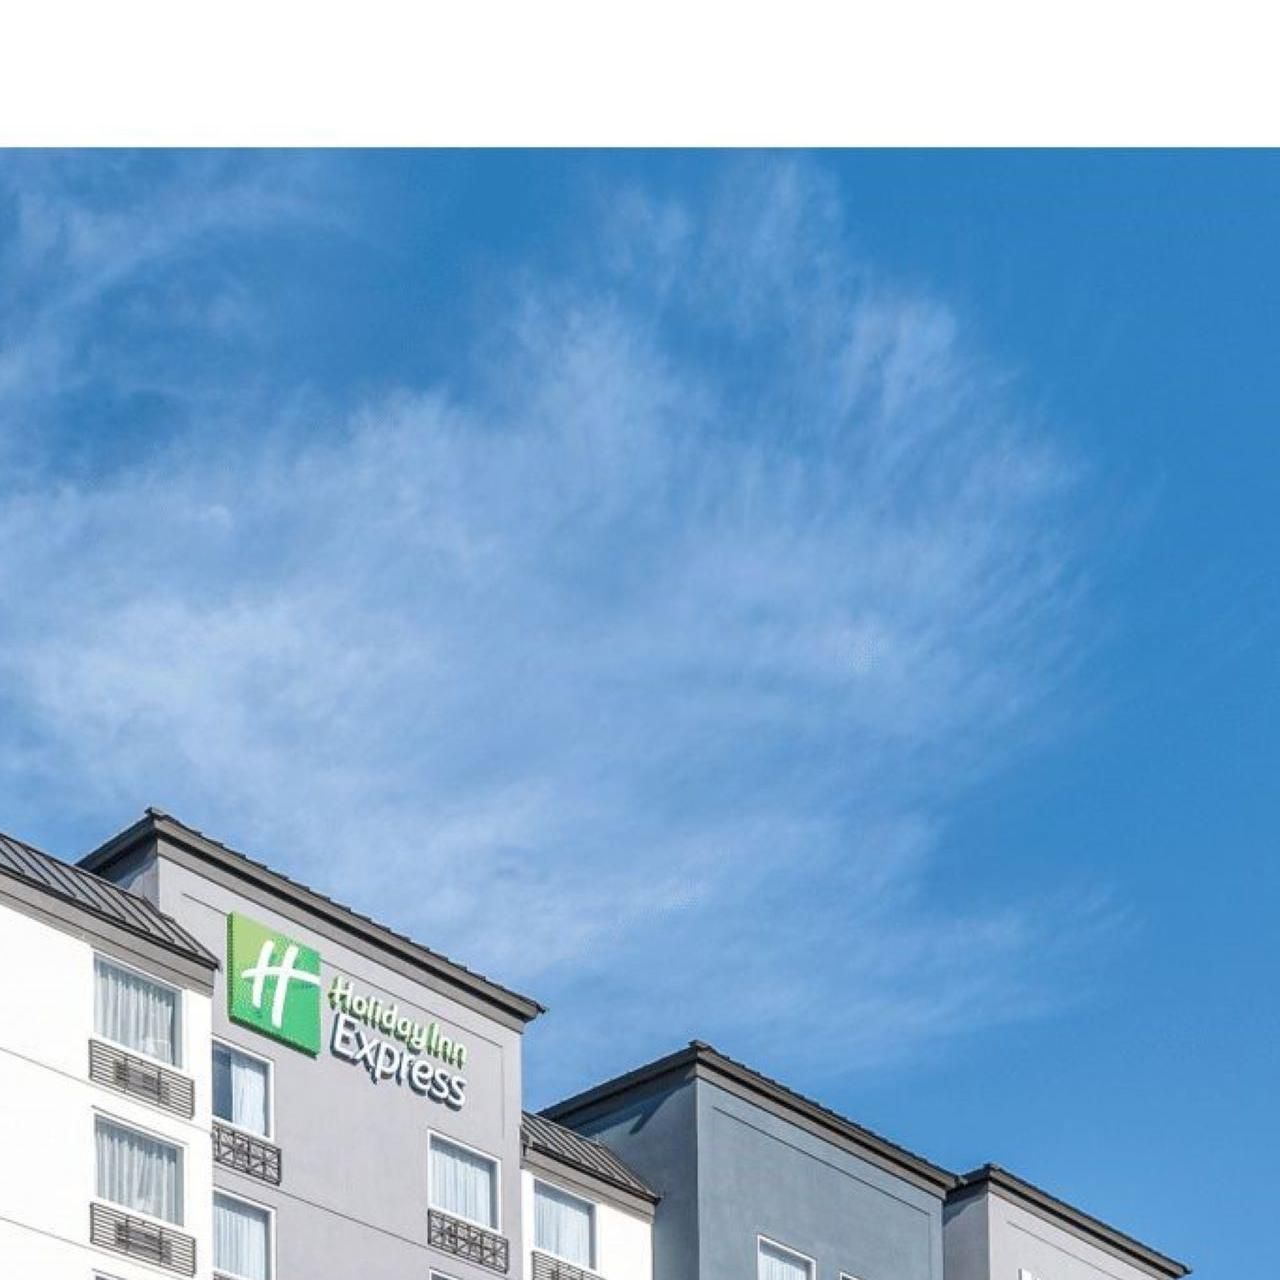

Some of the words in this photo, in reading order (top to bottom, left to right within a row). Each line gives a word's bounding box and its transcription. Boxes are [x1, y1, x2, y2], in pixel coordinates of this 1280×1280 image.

[328, 974, 426, 1055] Holiday
[427, 1022, 467, 1070] Inn
[330, 1012, 467, 1112] Express
